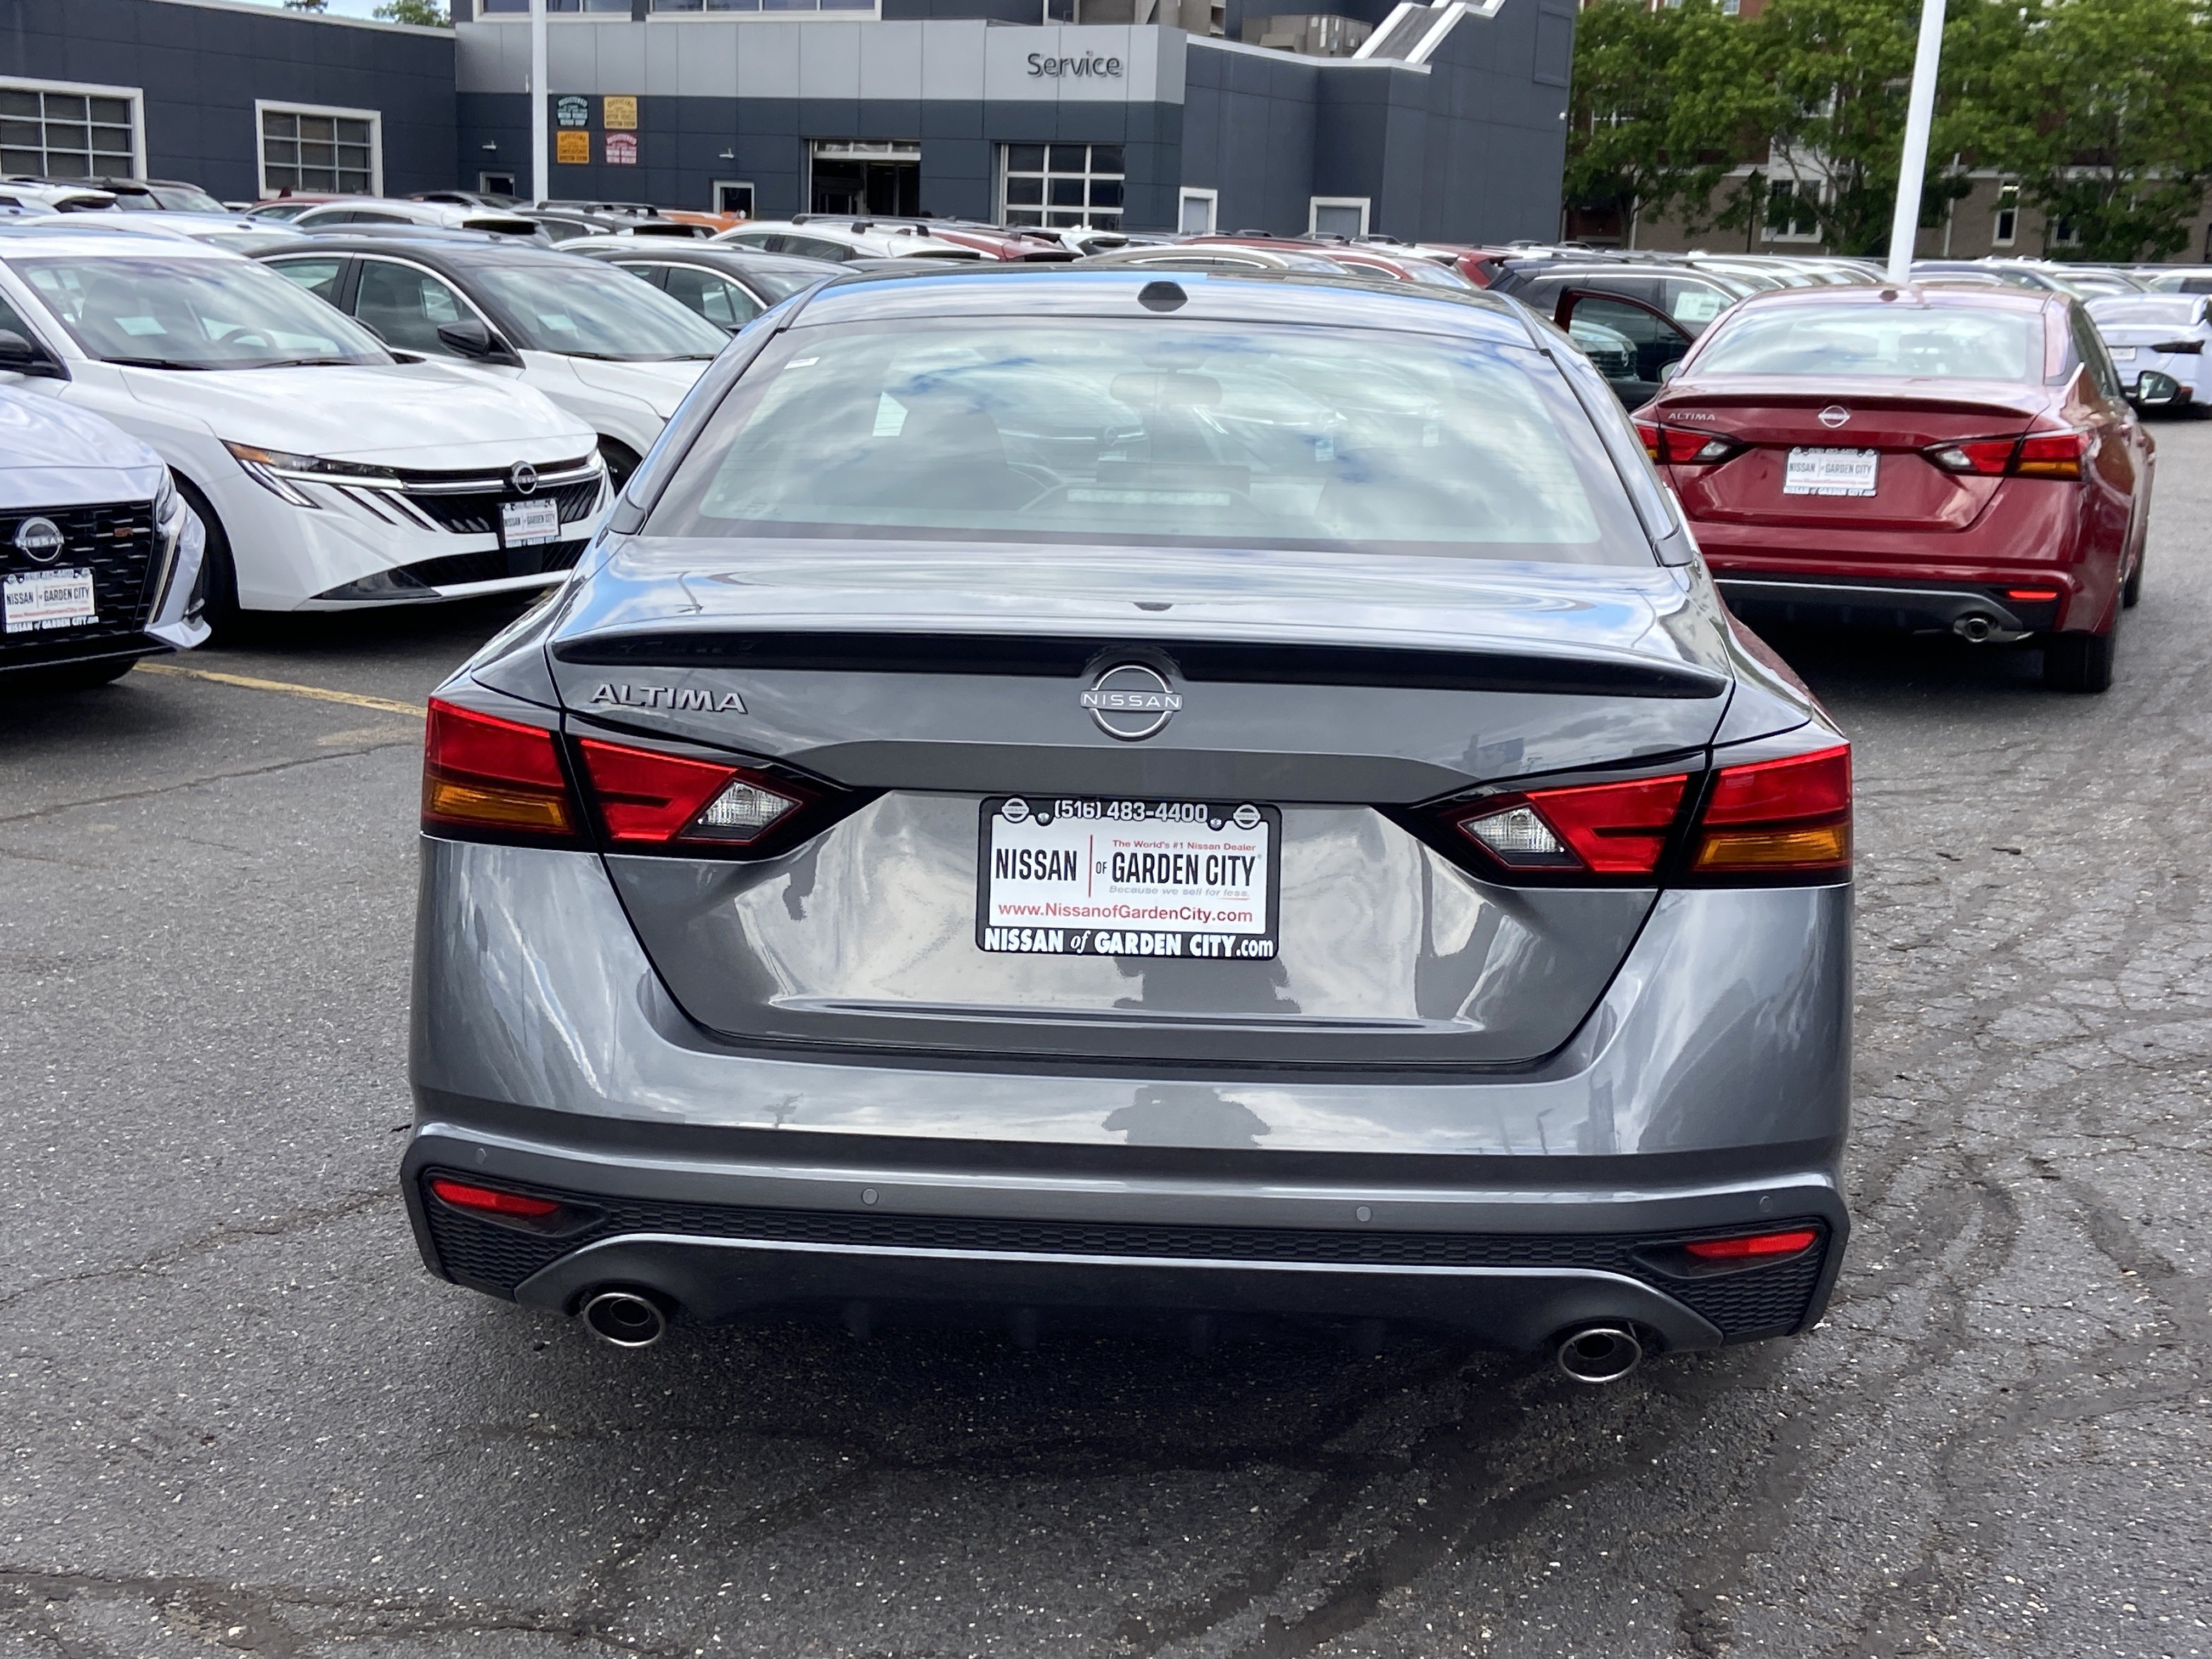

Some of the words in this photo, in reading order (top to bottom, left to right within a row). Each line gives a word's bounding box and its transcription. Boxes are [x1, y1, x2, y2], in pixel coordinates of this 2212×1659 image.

[1027, 50, 1121, 76] Service
[607, 99, 634, 108] OFFICIAL
[560, 133, 586, 142] OFFICIAL
[1668, 413, 1716, 421] ALTIMA
[1789, 463, 1816, 472] NISSAN
[1826, 464, 1853, 474] GARDEN
[1855, 465, 1872, 475] CITY
[15, 535, 65, 548] NISSAN
[7, 592, 33, 605] NISSAN
[44, 588, 72, 601] GARDEN
[74, 587, 90, 599] CITY
[590, 684, 748, 714] ALTIMA
[1083, 693, 1179, 708] NISSAN
[1054, 800, 1102, 819] (516)
[1107, 801, 1208, 822] 483-4400
[1113, 839, 1130, 848] The
[1133, 840, 1170, 849] World's
[1187, 842, 1220, 850] Nissan
[1223, 843, 1256, 851] Dealer
[996, 848, 1077, 881] NISSAN
[1096, 861, 1107, 874] OF
[1112, 851, 1199, 884] GARDEN
[1206, 855, 1255, 886] CITY
[1109, 885, 1158, 895] Because
[1183, 888, 1201, 896] sell
[1205, 888, 1220, 896] for
[1223, 889, 1250, 897] less.
[998, 902, 1252, 923] www.NissanofGardenCity.com
[985, 928, 1064, 952] NISSAN
[1070, 929, 1091, 953] of
[1094, 931, 1182, 955] GARDEN
[1189, 934, 1274, 957] CITY.com
